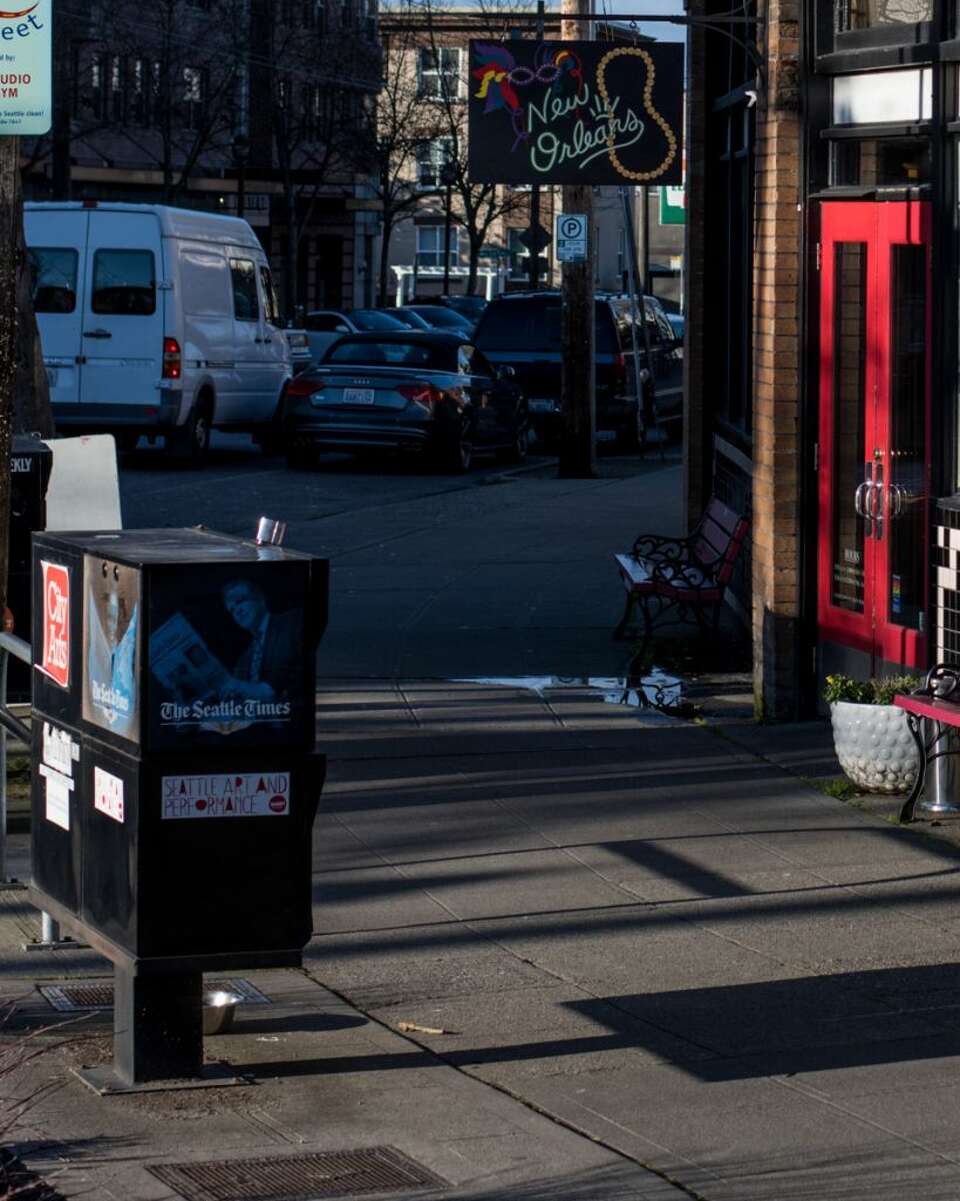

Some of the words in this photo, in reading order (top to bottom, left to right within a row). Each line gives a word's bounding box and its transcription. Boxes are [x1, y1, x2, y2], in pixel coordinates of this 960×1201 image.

[1, 13, 44, 41] eet
[0, 73, 32, 85] UDIO
[0, 87, 19, 98] YM
[528, 83, 590, 133] New
[530, 108, 645, 172] Orleans
[10, 457, 33, 473] EKLY
[47, 579, 68, 635] City
[47, 624, 68, 671] Arts
[160, 701, 190, 721] The
[191, 699, 242, 719] Seattle
[243, 698, 291, 717] Times
[164, 776, 217, 798] SEATTLE
[223, 776, 251, 794] ART
[256, 774, 288, 794] AND
[164, 794, 257, 817] PERFORMANCE
